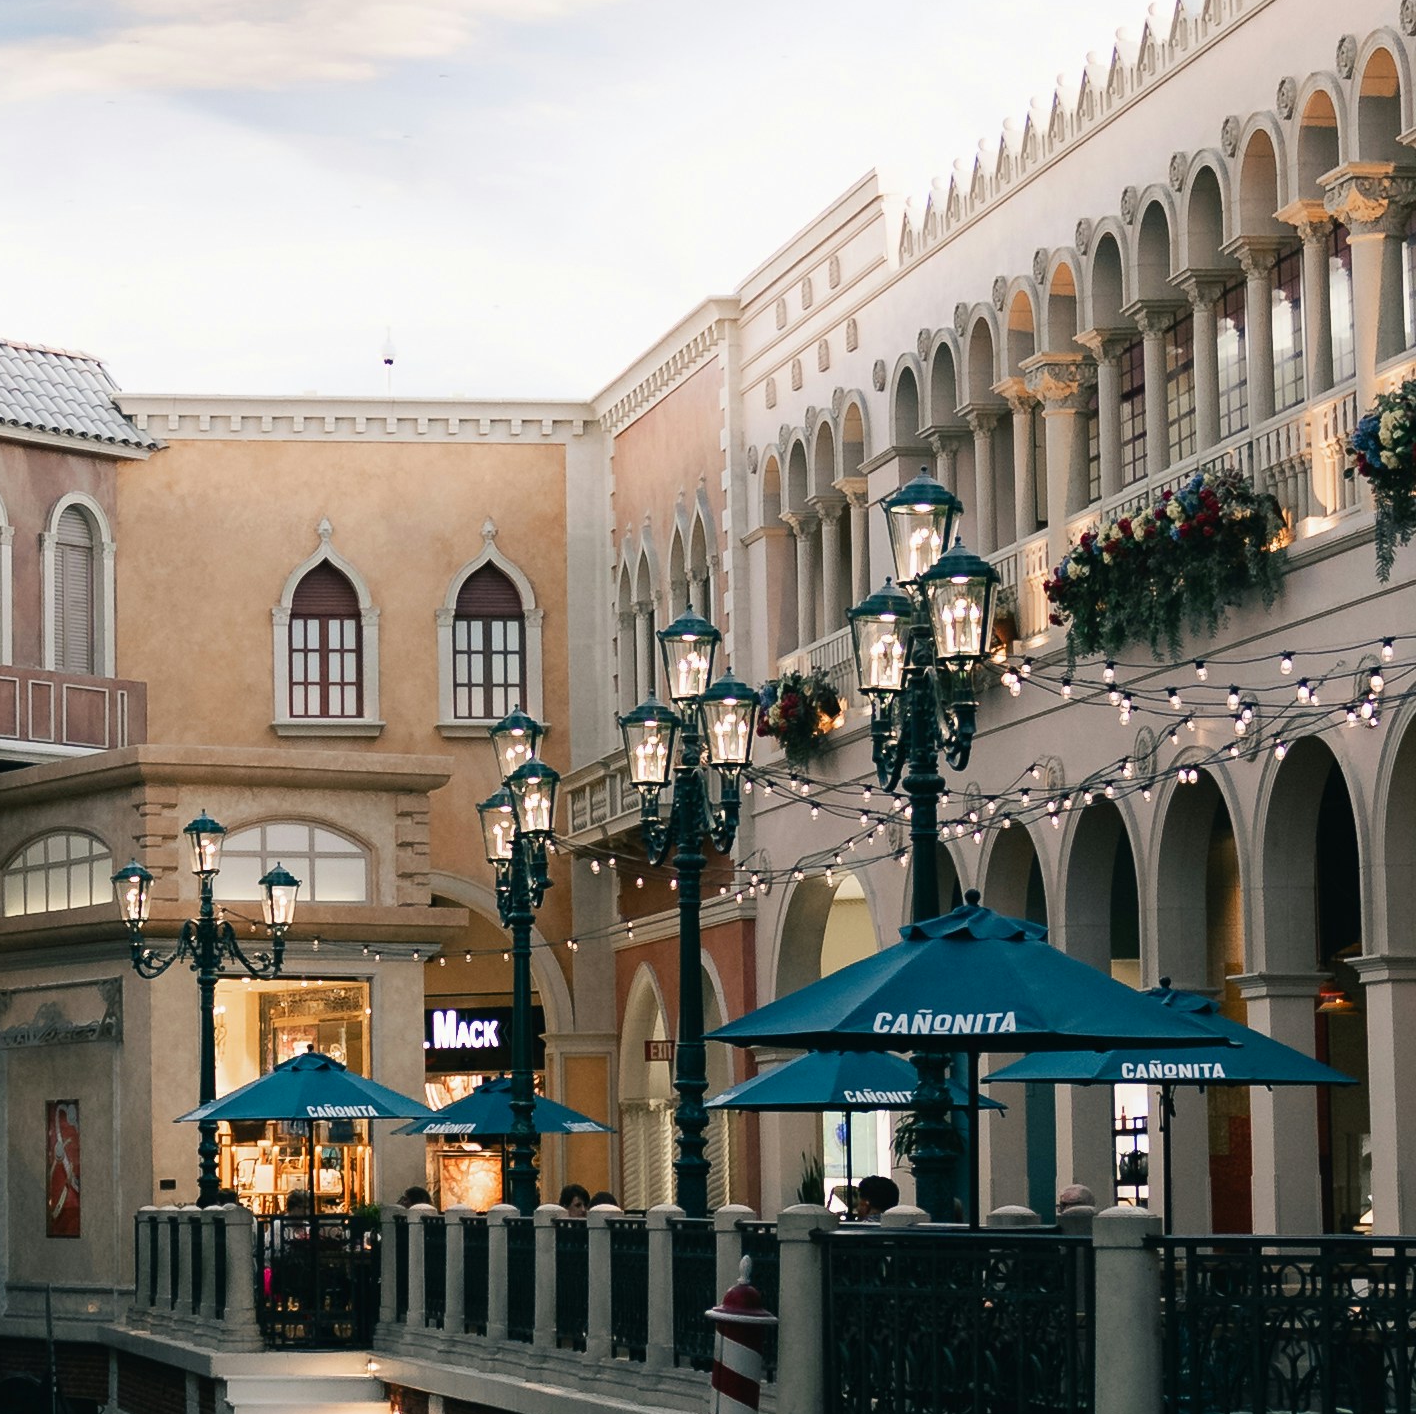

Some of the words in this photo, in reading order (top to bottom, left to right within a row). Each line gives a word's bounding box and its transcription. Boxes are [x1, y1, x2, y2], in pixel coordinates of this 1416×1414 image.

[872, 1008, 1017, 1035] CAÑONITA
[650, 1042, 673, 1060] EXIT
[1121, 1060, 1226, 1079] CAÑONITA
[843, 1088, 917, 1103] CAÑONIT
[306, 1103, 380, 1118] CAÑONITA
